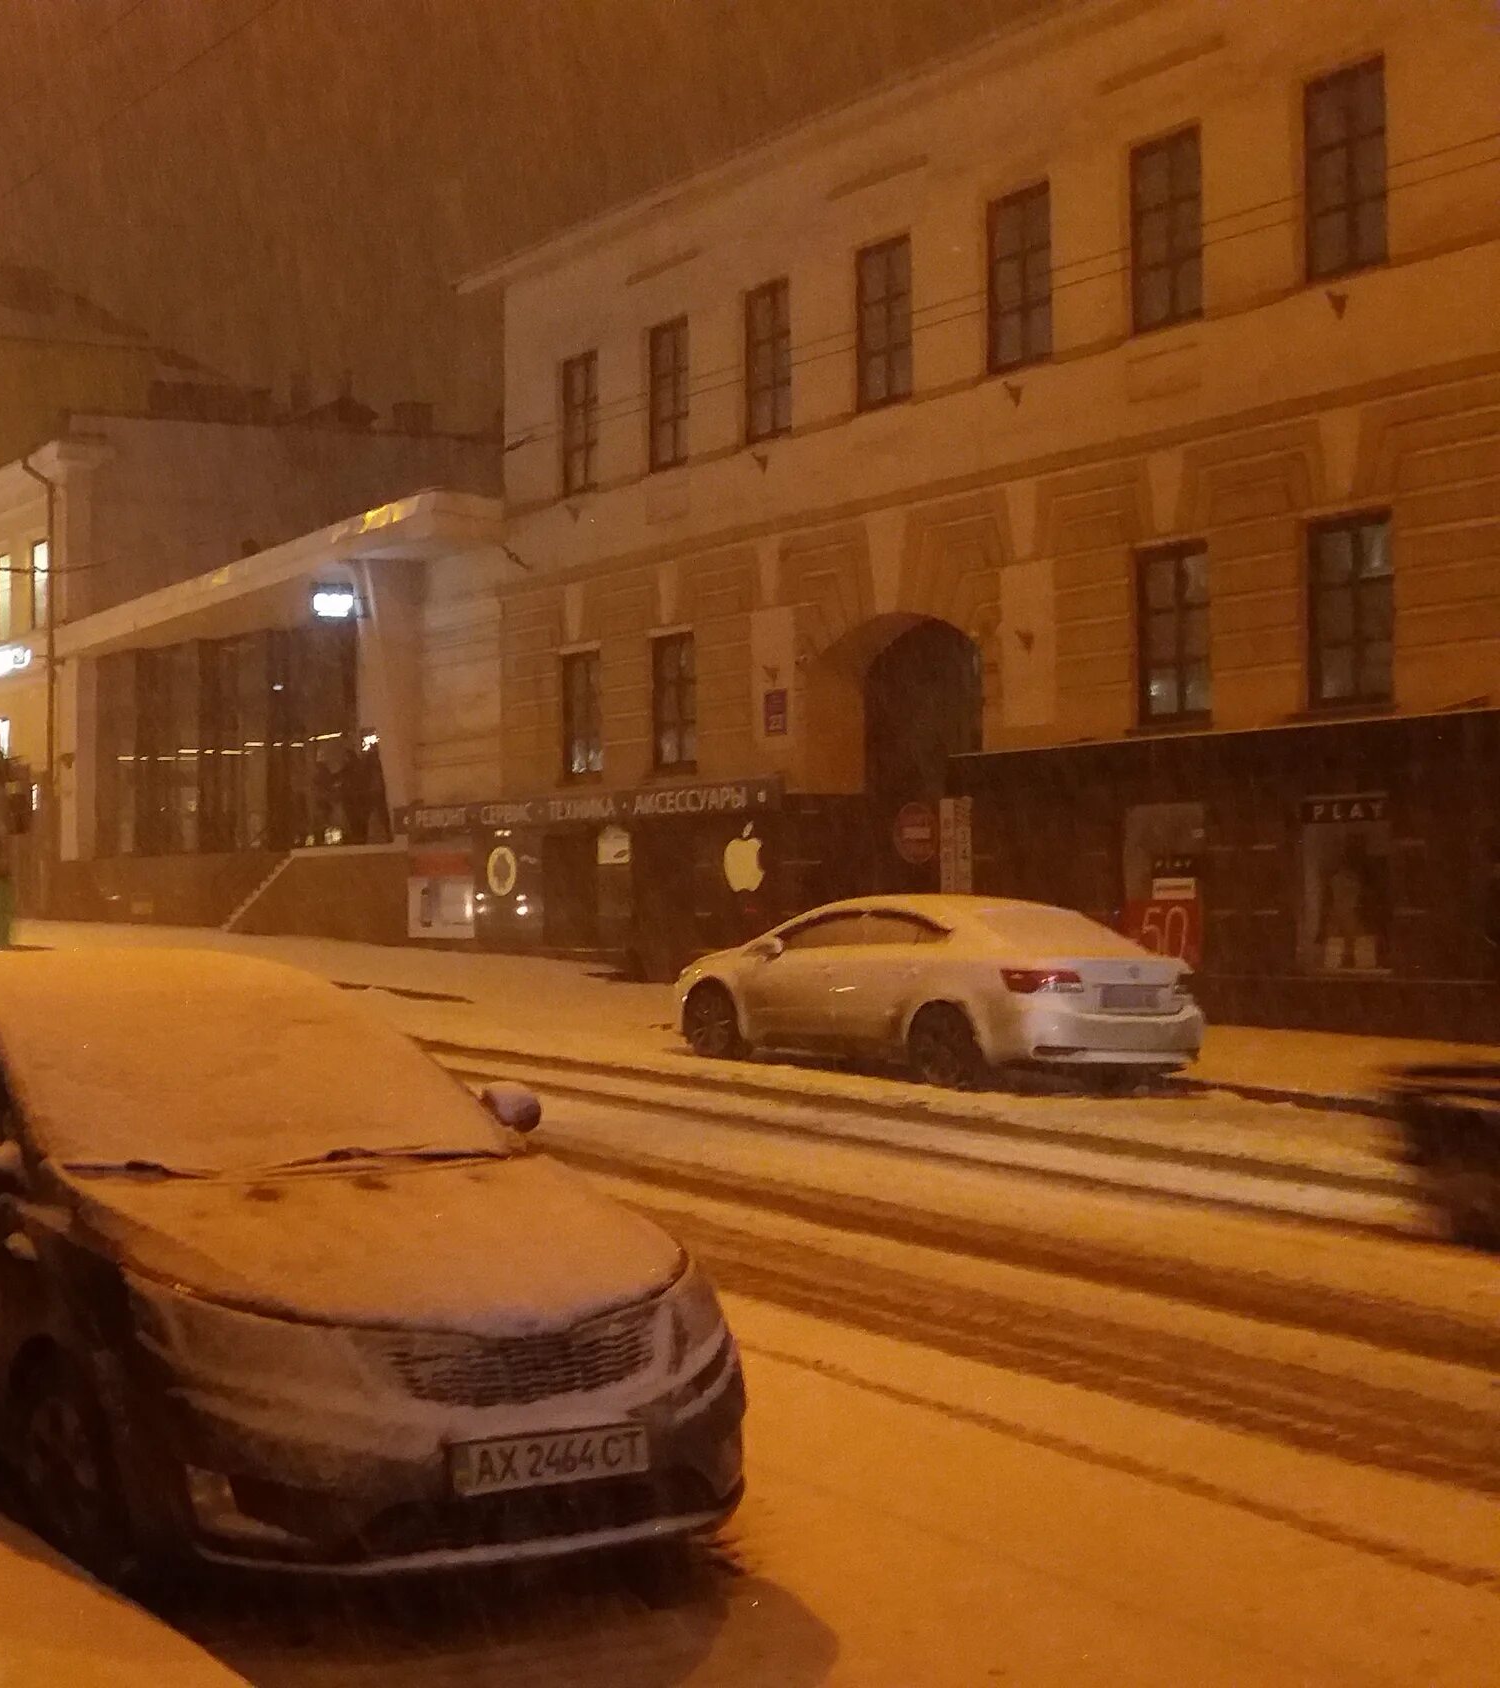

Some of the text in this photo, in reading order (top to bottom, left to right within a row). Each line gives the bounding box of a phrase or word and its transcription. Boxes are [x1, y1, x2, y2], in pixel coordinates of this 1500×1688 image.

[548, 797, 616, 821] ТЕХНИКА
[633, 787, 748, 815] АКСЕССУАРЫ
[1312, 801, 1384, 821] PLAY
[476, 1430, 643, 1485] AX 2464 CT
